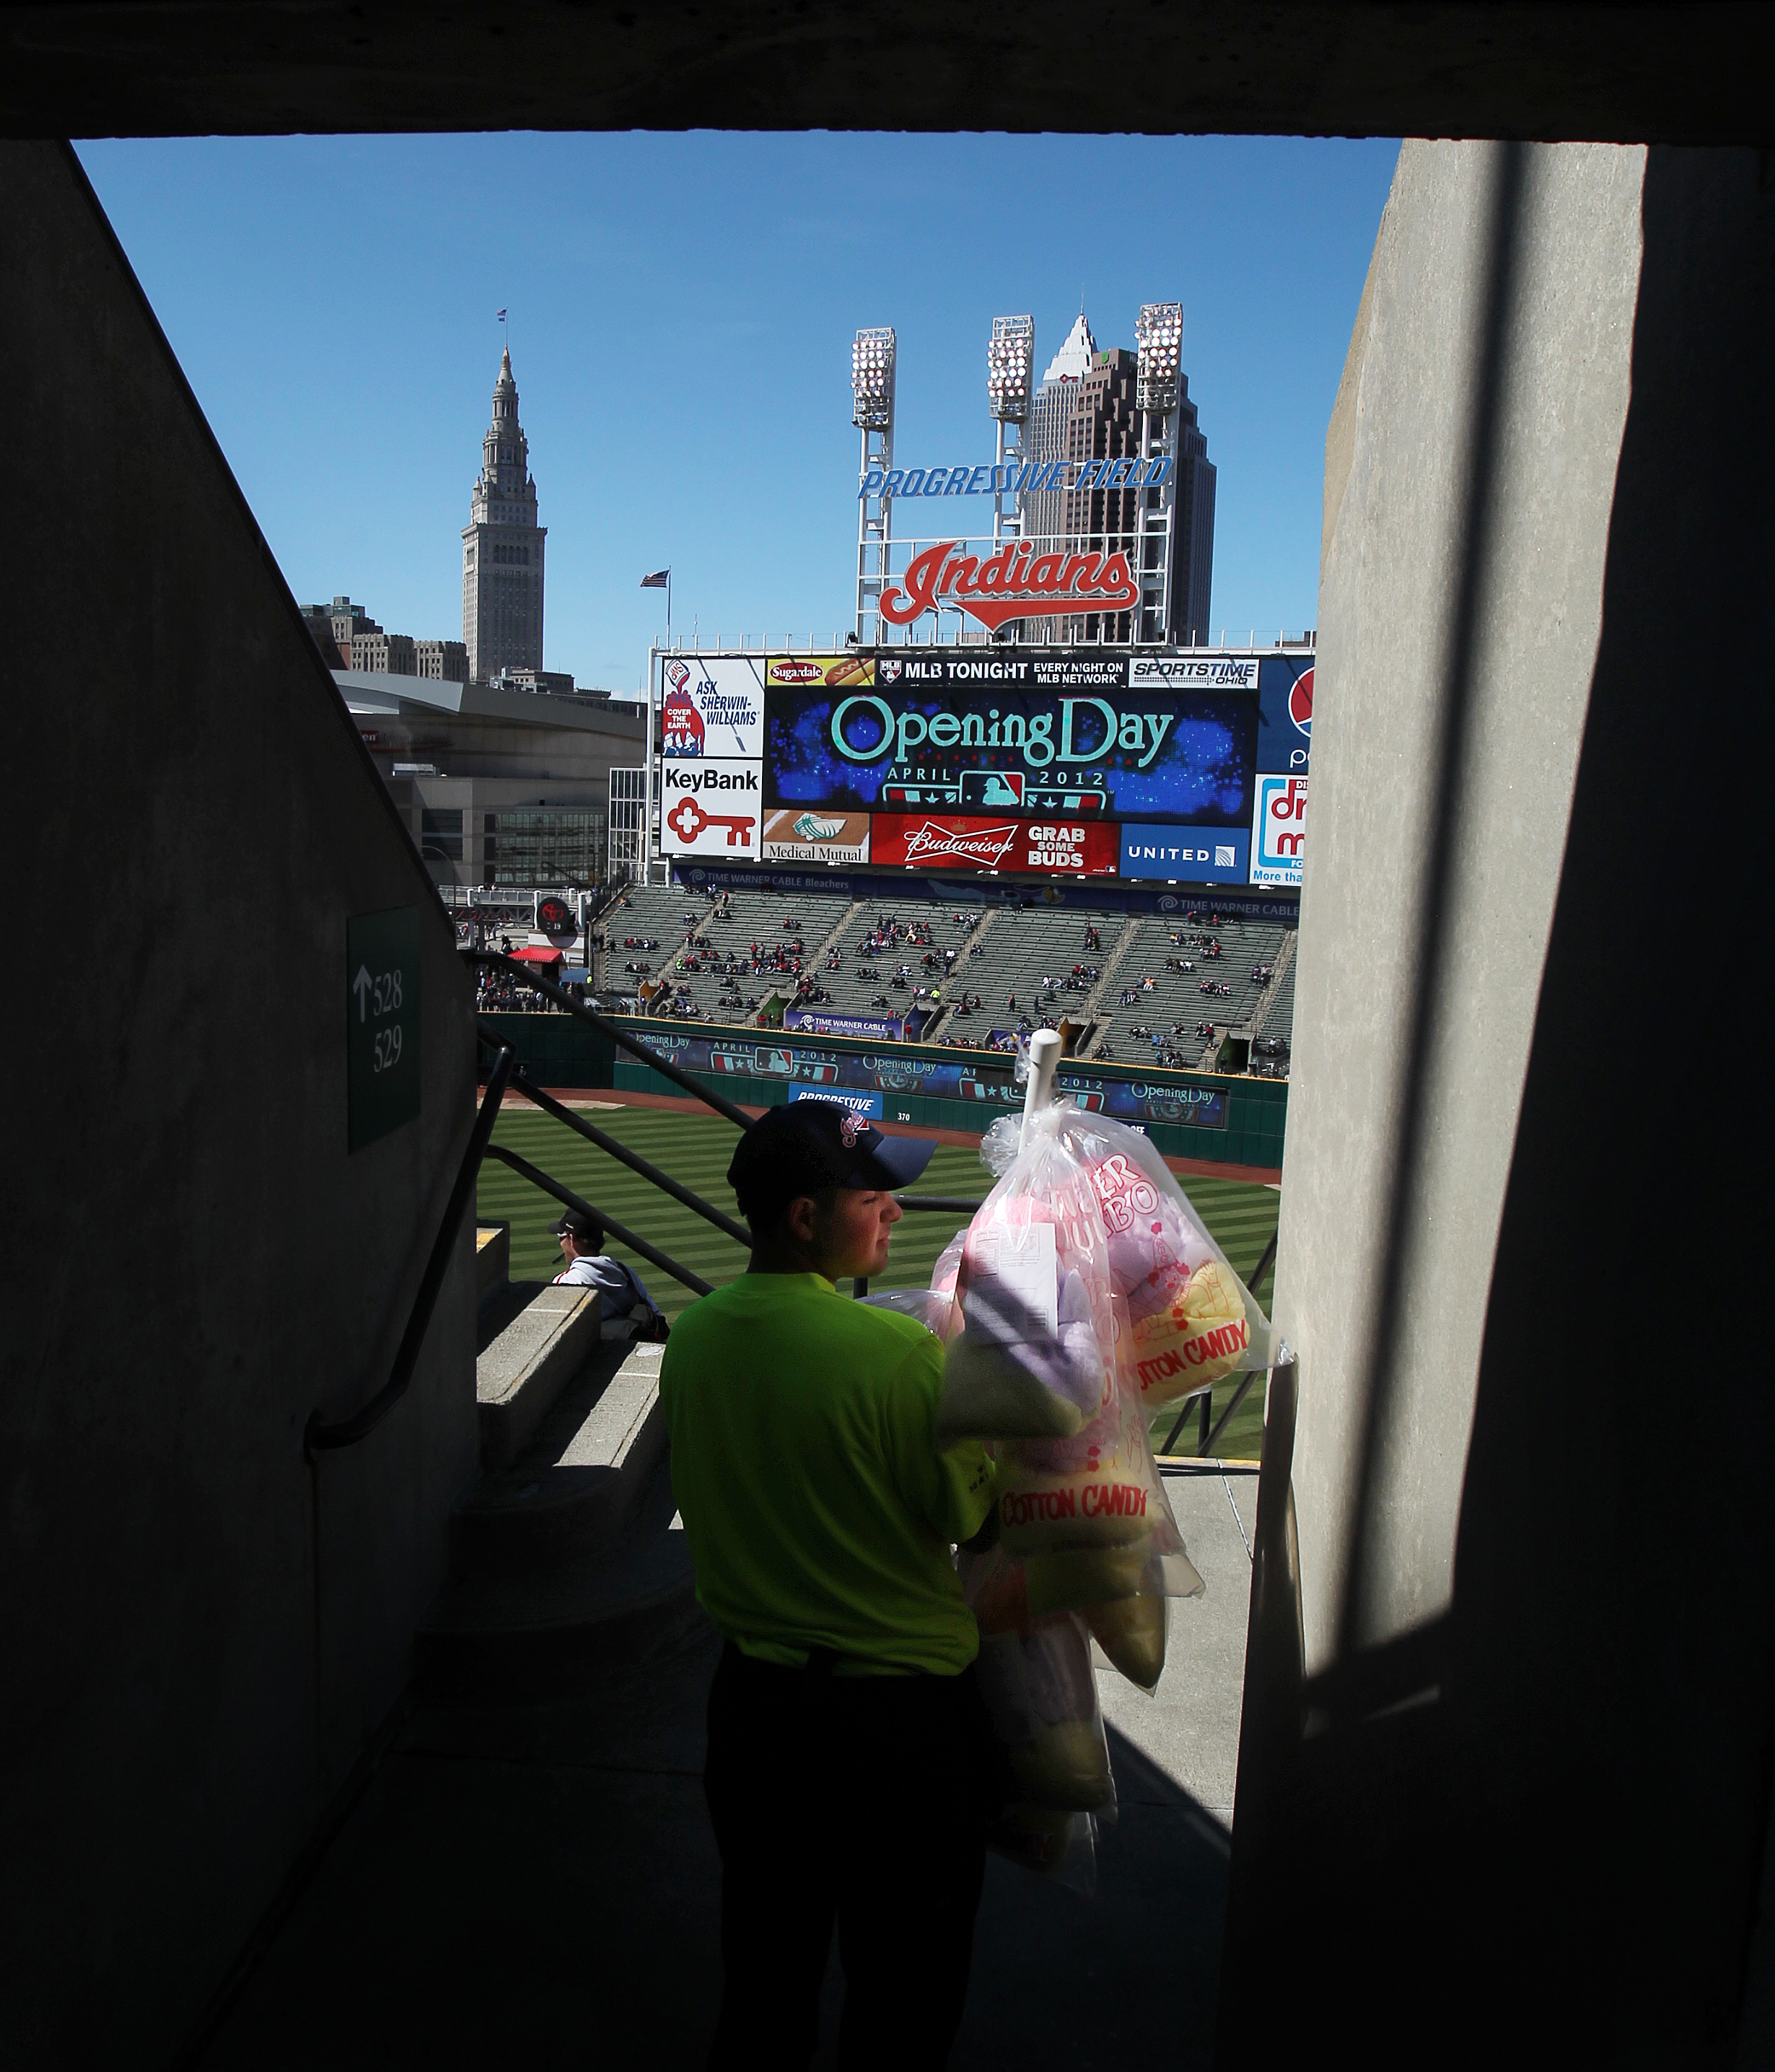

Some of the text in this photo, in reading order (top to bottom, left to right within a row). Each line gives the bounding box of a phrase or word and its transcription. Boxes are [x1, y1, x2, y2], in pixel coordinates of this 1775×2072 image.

[857, 457, 1173, 499] PROGRESSIVE FIELD
[878, 539, 1141, 631] Indians
[772, 665, 822, 678] Sugardale
[906, 663, 1028, 679] MLB TONIGHT
[1033, 663, 1123, 673] EVERY NIGHT ON
[1134, 663, 1256, 677] SPORTSTIME
[1037, 673, 1118, 683] MLB NETWORK
[1215, 676, 1248, 685] OHIO
[696, 681, 717, 695] ASK
[700, 696, 752, 710] SHERWIN-
[706, 711, 757, 725] WILLIAMS
[665, 768, 758, 792] KeyBank
[888, 767, 951, 782] APRIL
[1039, 771, 1103, 785] 2012
[1027, 826, 1086, 843] GRAB
[903, 831, 1014, 854] Budweiser
[1037, 841, 1075, 852] SOME
[769, 844, 862, 862] Medical Mutual
[1027, 850, 1084, 867] BUDS
[1128, 845, 1210, 862] UNITED
[707, 872, 849, 889] TIME WARNER CABLE Bleachers
[1253, 870, 1281, 881] More
[1180, 899, 1300, 917] TIME WARNER CABLE
[373, 969, 403, 1016] 528
[815, 1017, 886, 1032] TIME WARNER CABLE
[373, 1024, 403, 1072] 529
[713, 1041, 750, 1053] APRIL
[800, 1050, 836, 1062] 2012
[1061, 1077, 1103, 1090] 2012
[897, 1112, 911, 1122] 370
[1183, 1319, 1248, 1365] CANDY
[1002, 1484, 1149, 1527] COTTON CANDY
